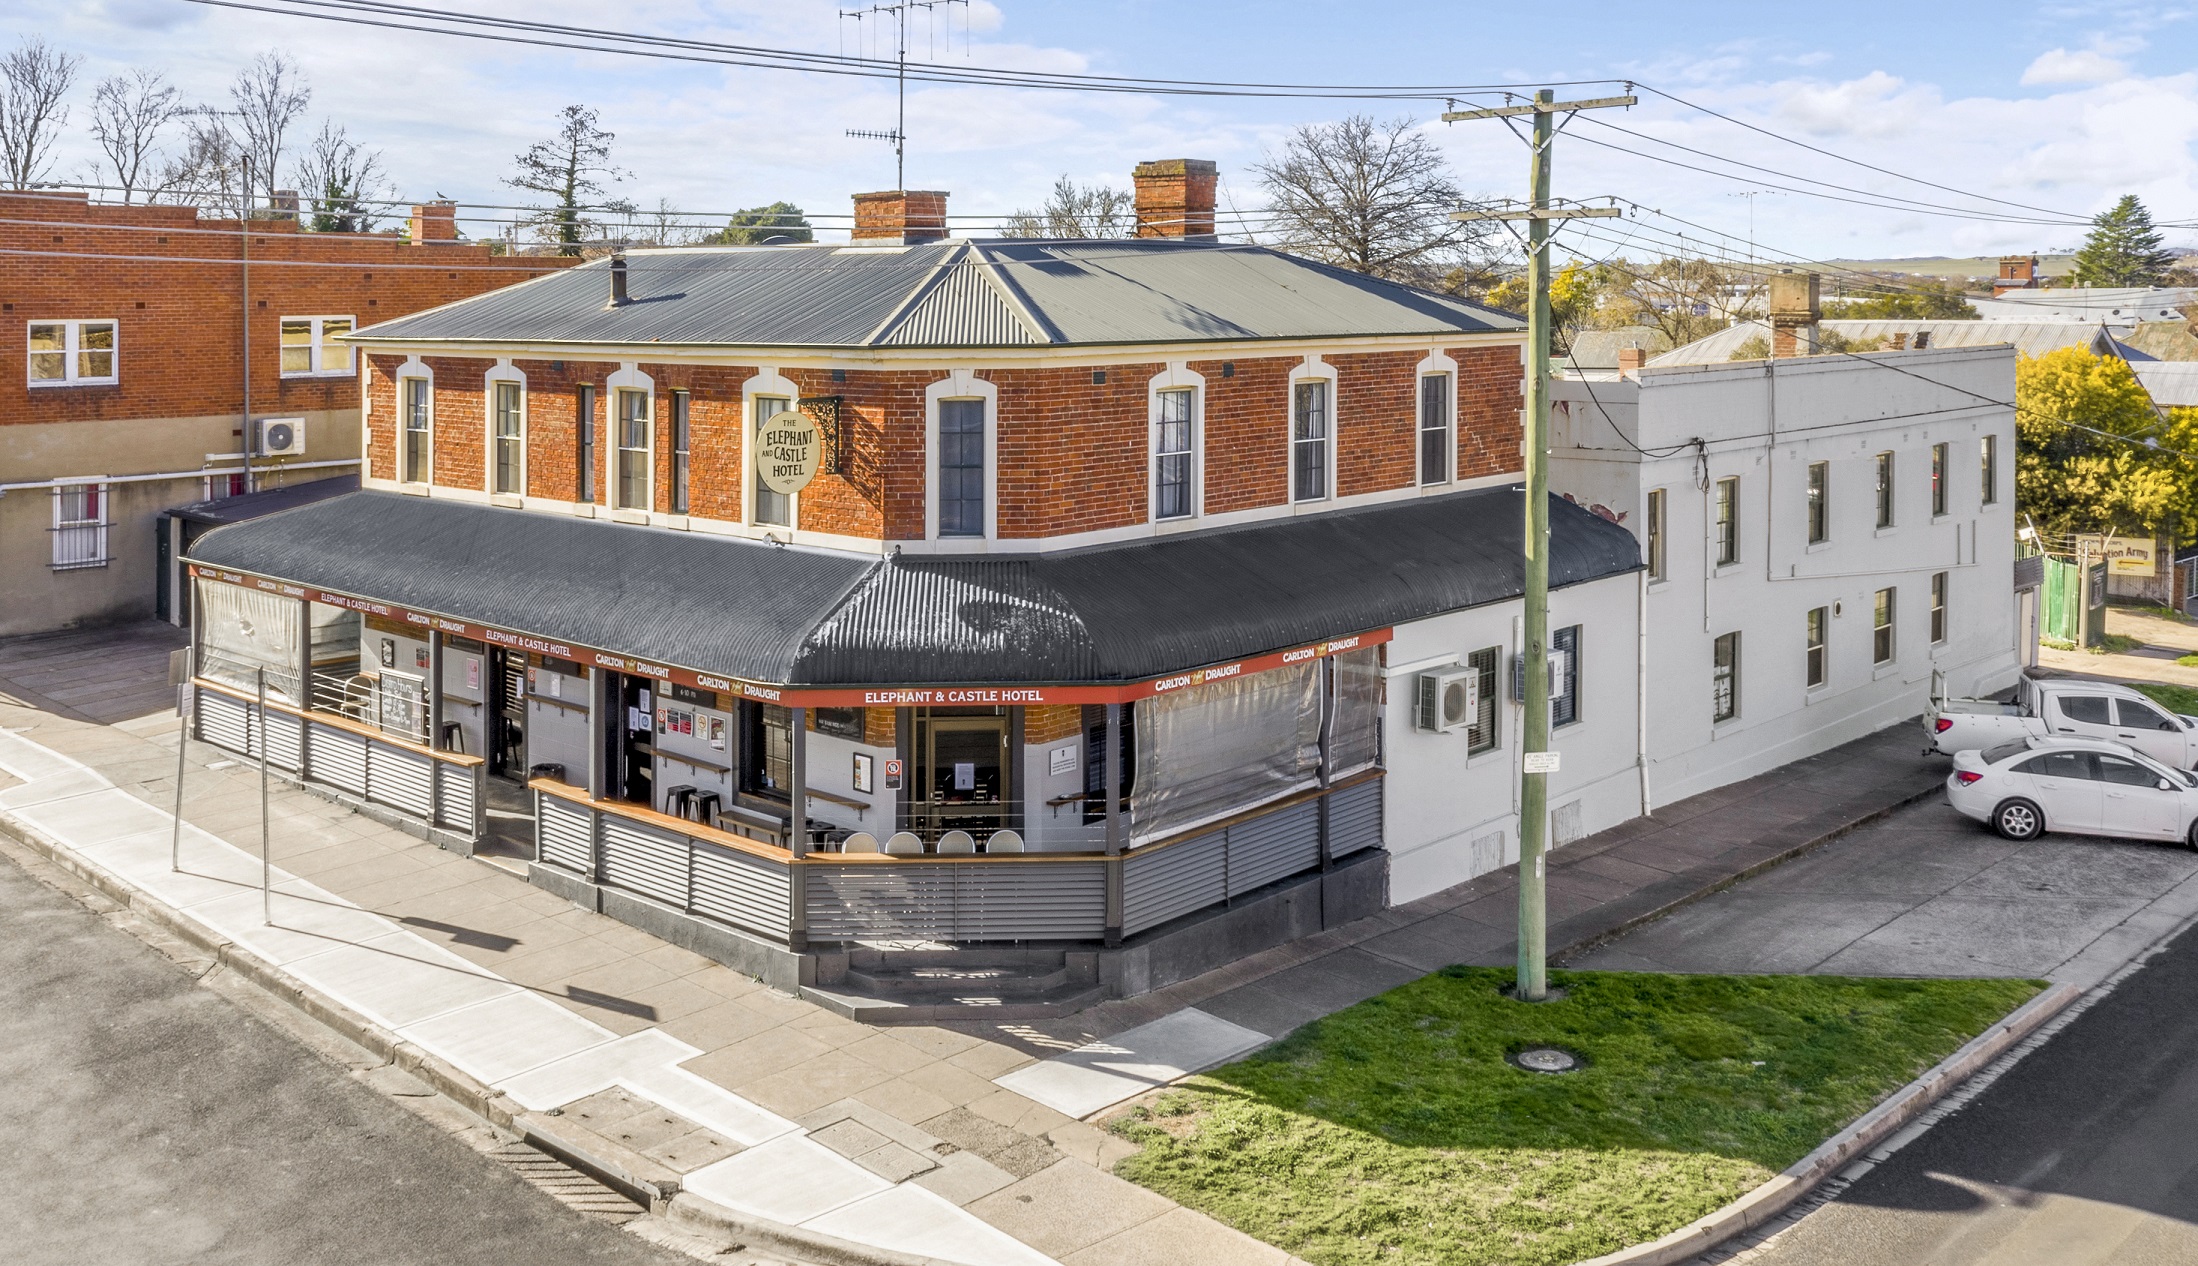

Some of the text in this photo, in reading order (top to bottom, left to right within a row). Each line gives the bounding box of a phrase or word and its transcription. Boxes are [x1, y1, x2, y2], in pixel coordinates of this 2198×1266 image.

[766, 429, 814, 447] ELEPHANT
[774, 446, 807, 462] CASTLE
[772, 464, 804, 477] HOTEL
[2126, 547, 2148, 560] Army
[321, 592, 346, 607] ELEPHANT
[351, 599, 371, 611] CASTLE
[371, 605, 388, 616] HOTEL
[407, 612, 466, 633] CARLTON DRAUGHT
[486, 629, 571, 657] ELEPHANT & CASTLE HOTEL
[1282, 637, 1359, 663] CARLTON DRAUGHT
[595, 653, 670, 678] CARLTON DRAUGHT
[697, 674, 781, 701] CARLTON DRAUGHT
[1155, 663, 1241, 692] CARLTON DRAUGHT
[865, 690, 1044, 703] ELEPHANT & CASTLE HOTEL
